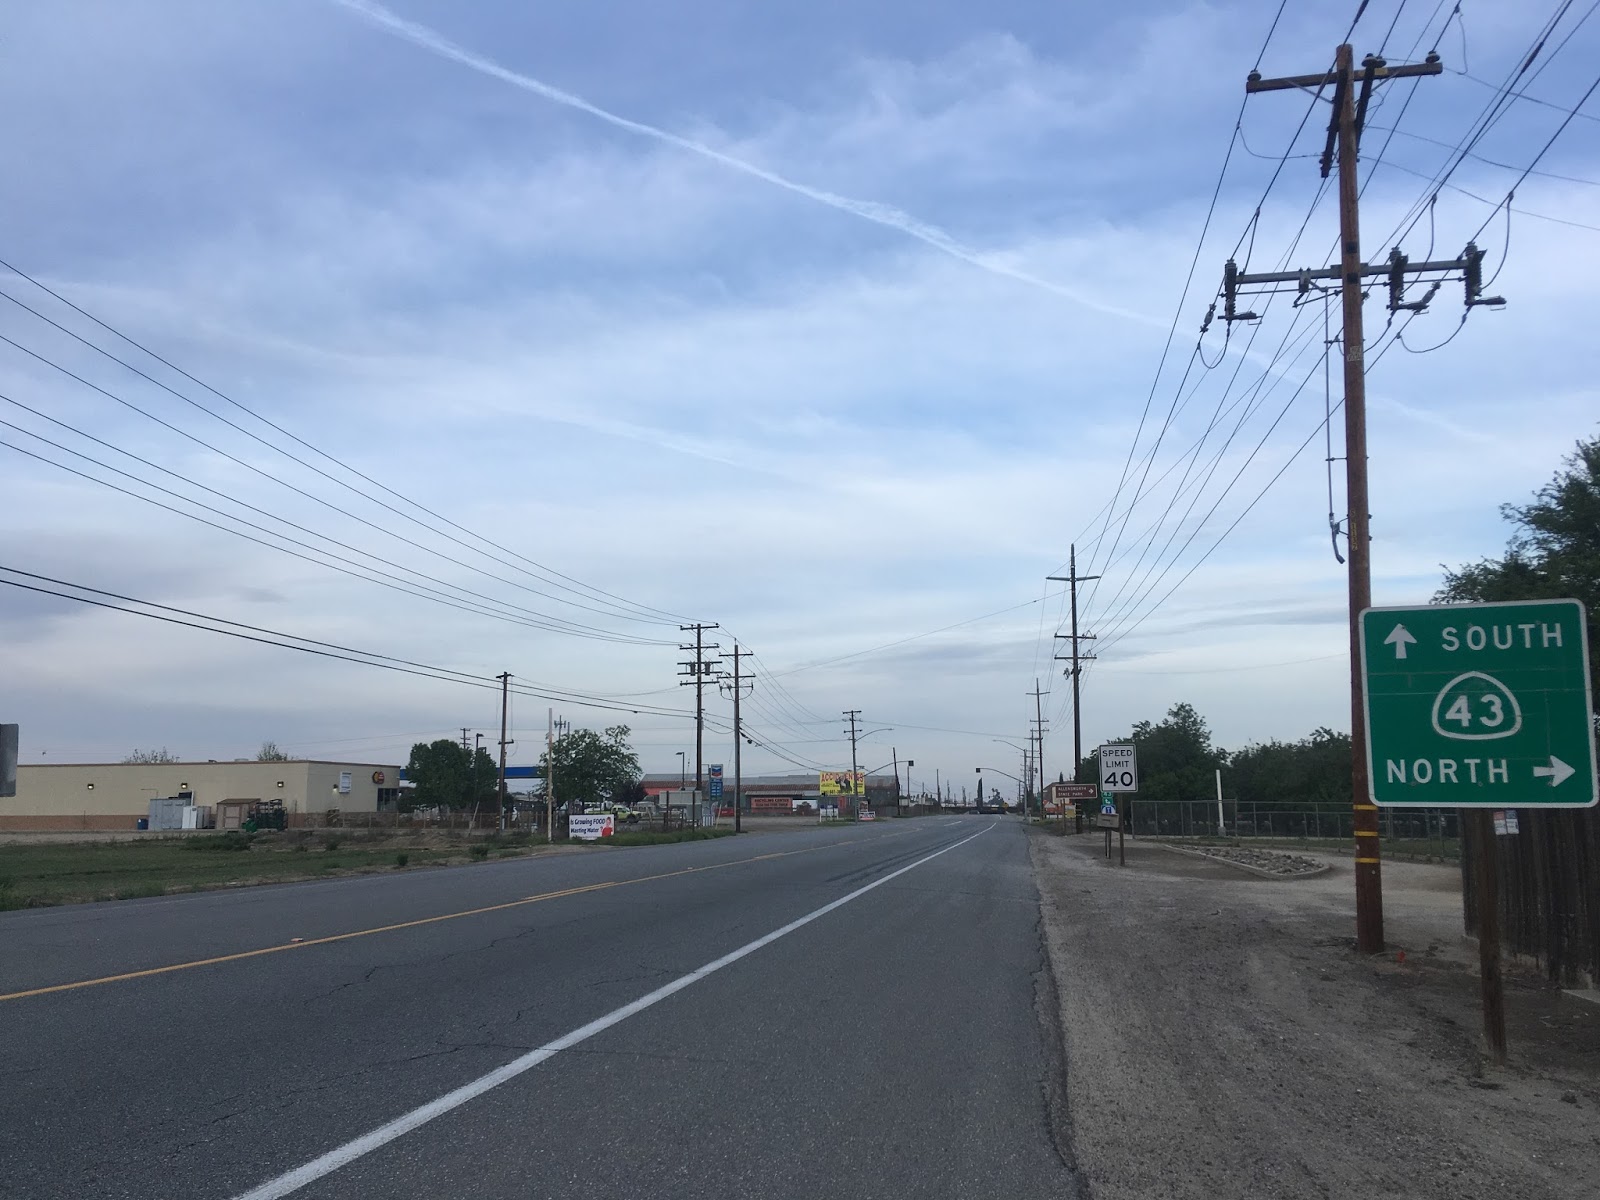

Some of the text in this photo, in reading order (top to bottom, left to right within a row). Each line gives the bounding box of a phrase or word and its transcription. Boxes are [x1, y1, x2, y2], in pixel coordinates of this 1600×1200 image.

[1442, 623, 1563, 651] SOUTH
[1445, 694, 1504, 727] 43
[1104, 771, 1133, 787] 40
[1387, 759, 1509, 784] NORTH
[575, 818, 593, 826] Growing
